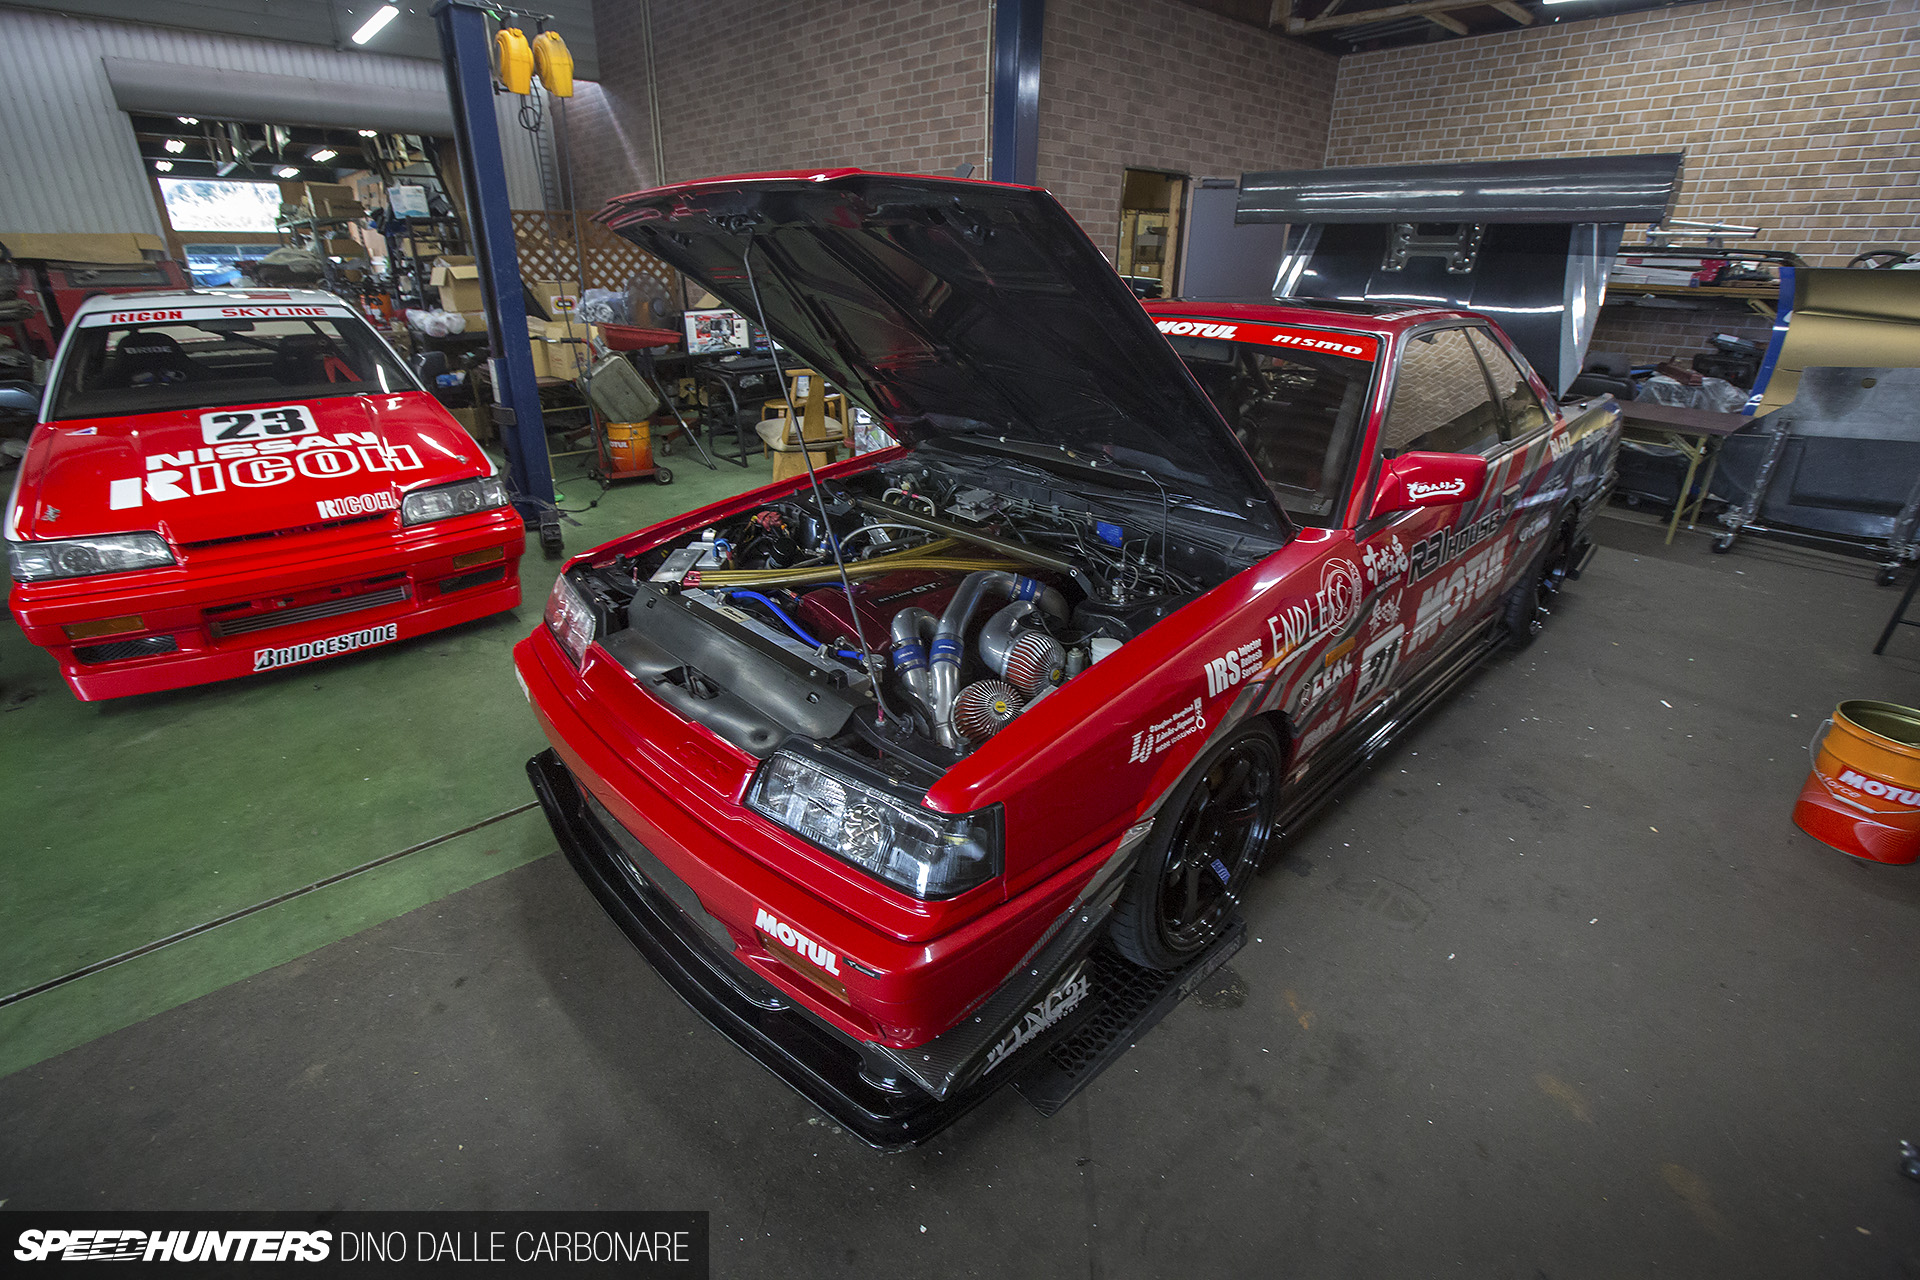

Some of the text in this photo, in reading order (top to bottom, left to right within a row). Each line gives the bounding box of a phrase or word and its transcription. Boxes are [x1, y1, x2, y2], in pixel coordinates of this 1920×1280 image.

[221, 307, 329, 318] SKYLINE
[1155, 320, 1363, 356] MOTUL nismo
[211, 406, 307, 442] 23
[145, 431, 380, 471] NISSAN
[109, 443, 424, 511] RICOH
[316, 490, 395, 519] RICOH
[1406, 533, 1510, 656] MOTUL
[253, 622, 398, 671] BRIDGESTONE
[1204, 650, 1242, 698] IRS
[1311, 652, 1353, 699] ZEAL
[1838, 770, 1920, 807] MOTU
[754, 907, 841, 977] MOTUL
